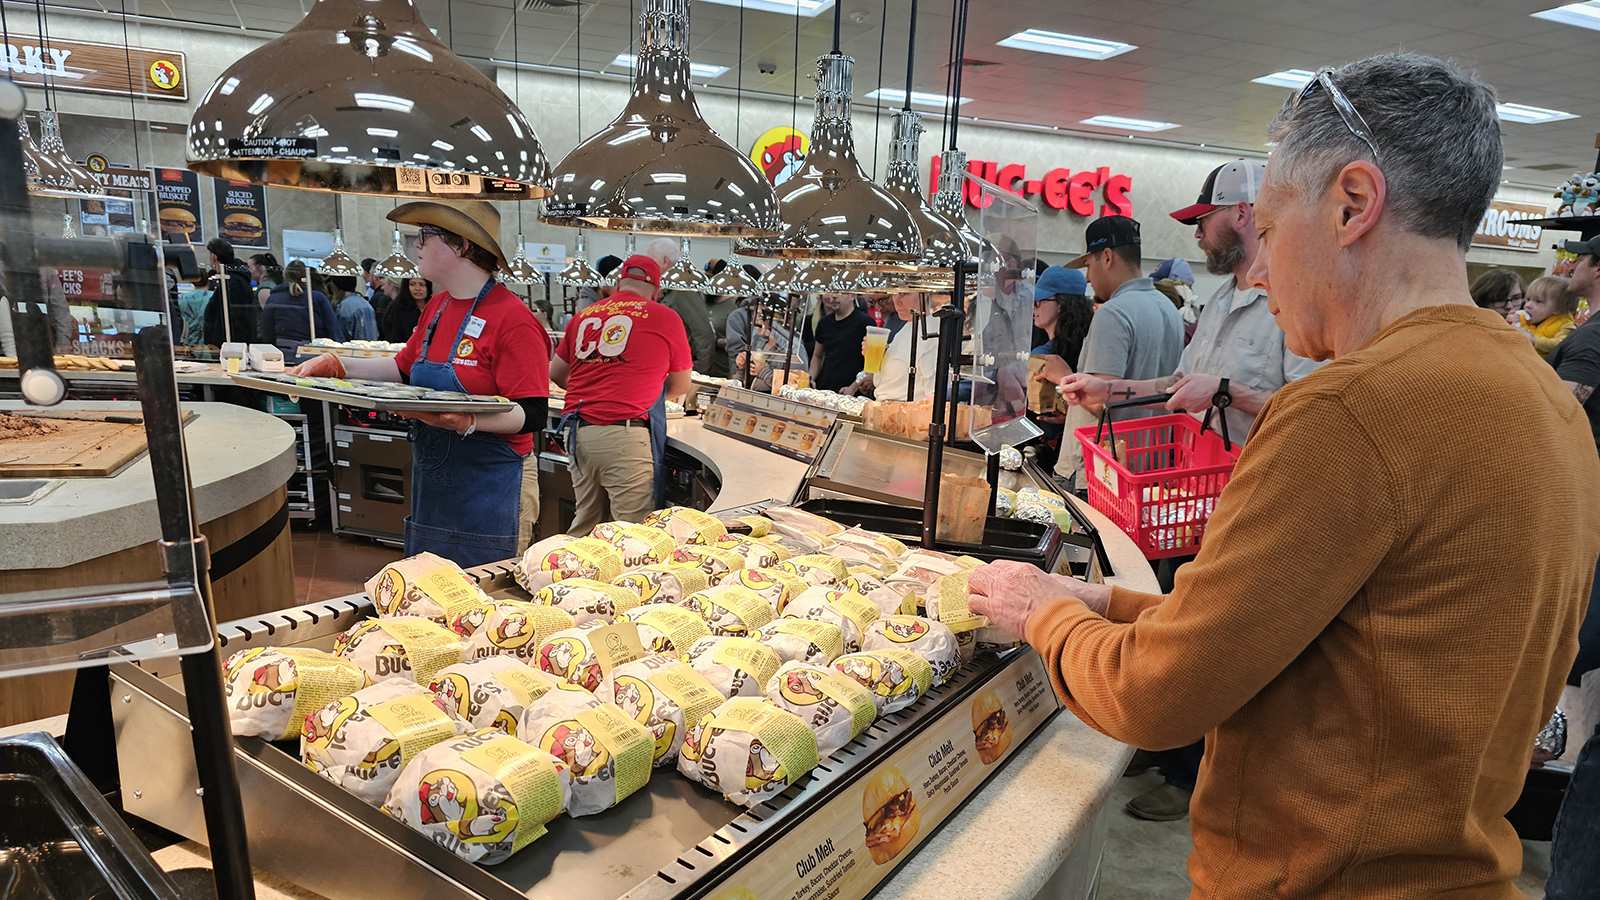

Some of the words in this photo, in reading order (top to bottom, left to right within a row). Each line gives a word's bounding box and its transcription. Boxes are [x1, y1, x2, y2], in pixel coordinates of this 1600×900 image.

[91, 172, 110, 185] TY
[111, 174, 150, 188] MEATS
[156, 184, 192, 194] CHOPPED
[159, 192, 189, 201] BRISKET
[227, 190, 253, 199] SLICED
[226, 197, 255, 206] BRISKET
[579, 300, 647, 318] Welcome
[72, 339, 125, 355] SNACKS
[928, 750, 942, 768] Club
[940, 740, 954, 758] Melt
[796, 854, 817, 879] Club
[814, 838, 835, 863] Melt
[795, 884, 811, 899] Turkey,
[810, 873, 825, 887] Bacon,
[823, 859, 839, 876] Cheddar
[825, 868, 843, 888] Sundried
[841, 858, 856, 873] Tomato
